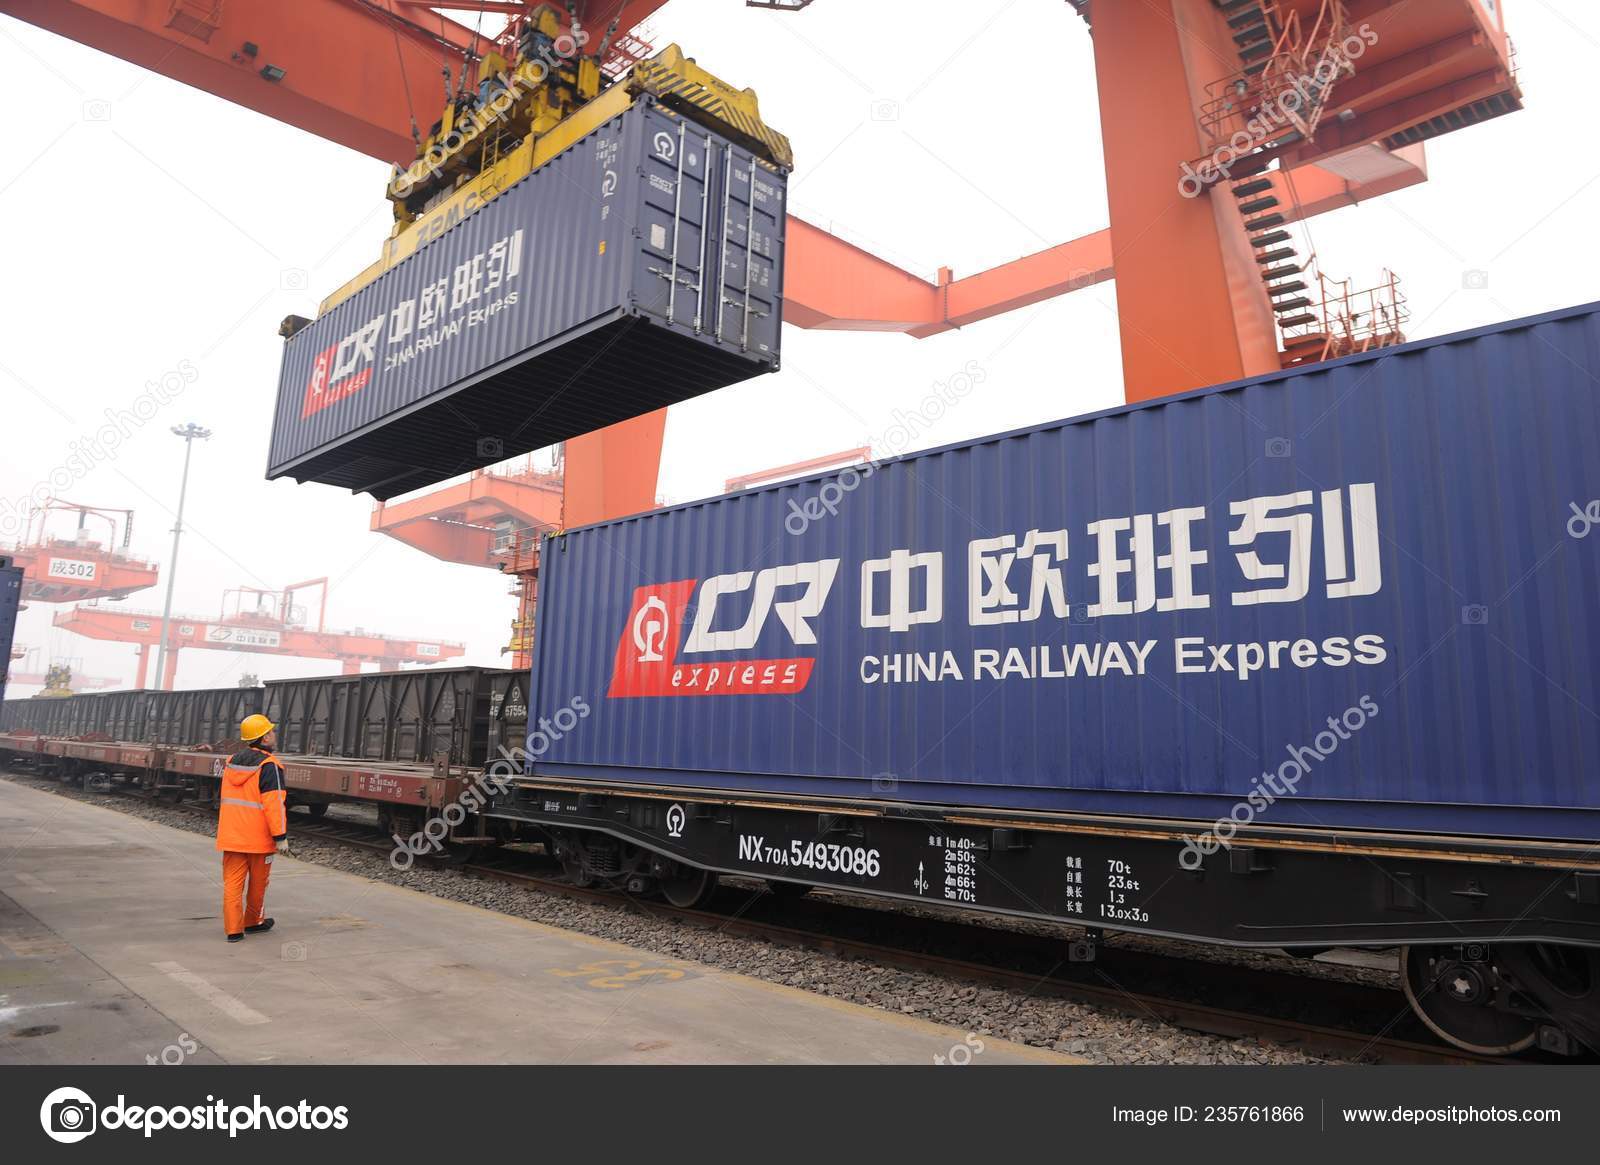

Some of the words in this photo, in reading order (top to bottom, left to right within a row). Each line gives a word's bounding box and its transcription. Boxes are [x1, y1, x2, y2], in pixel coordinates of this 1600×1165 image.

[415, 315, 465, 354] RALWAY
[860, 481, 1383, 632] 中欧班列
[683, 557, 841, 654] CR
[859, 649, 964, 685] CHINA
[972, 639, 1159, 682] RAILWAY
[1174, 633, 1388, 681] Express
[671, 662, 798, 691] express
[1107, 859, 1132, 874] 70t
[1108, 875, 1140, 891] 23.6t
[1110, 889, 1125, 904] 1.3
